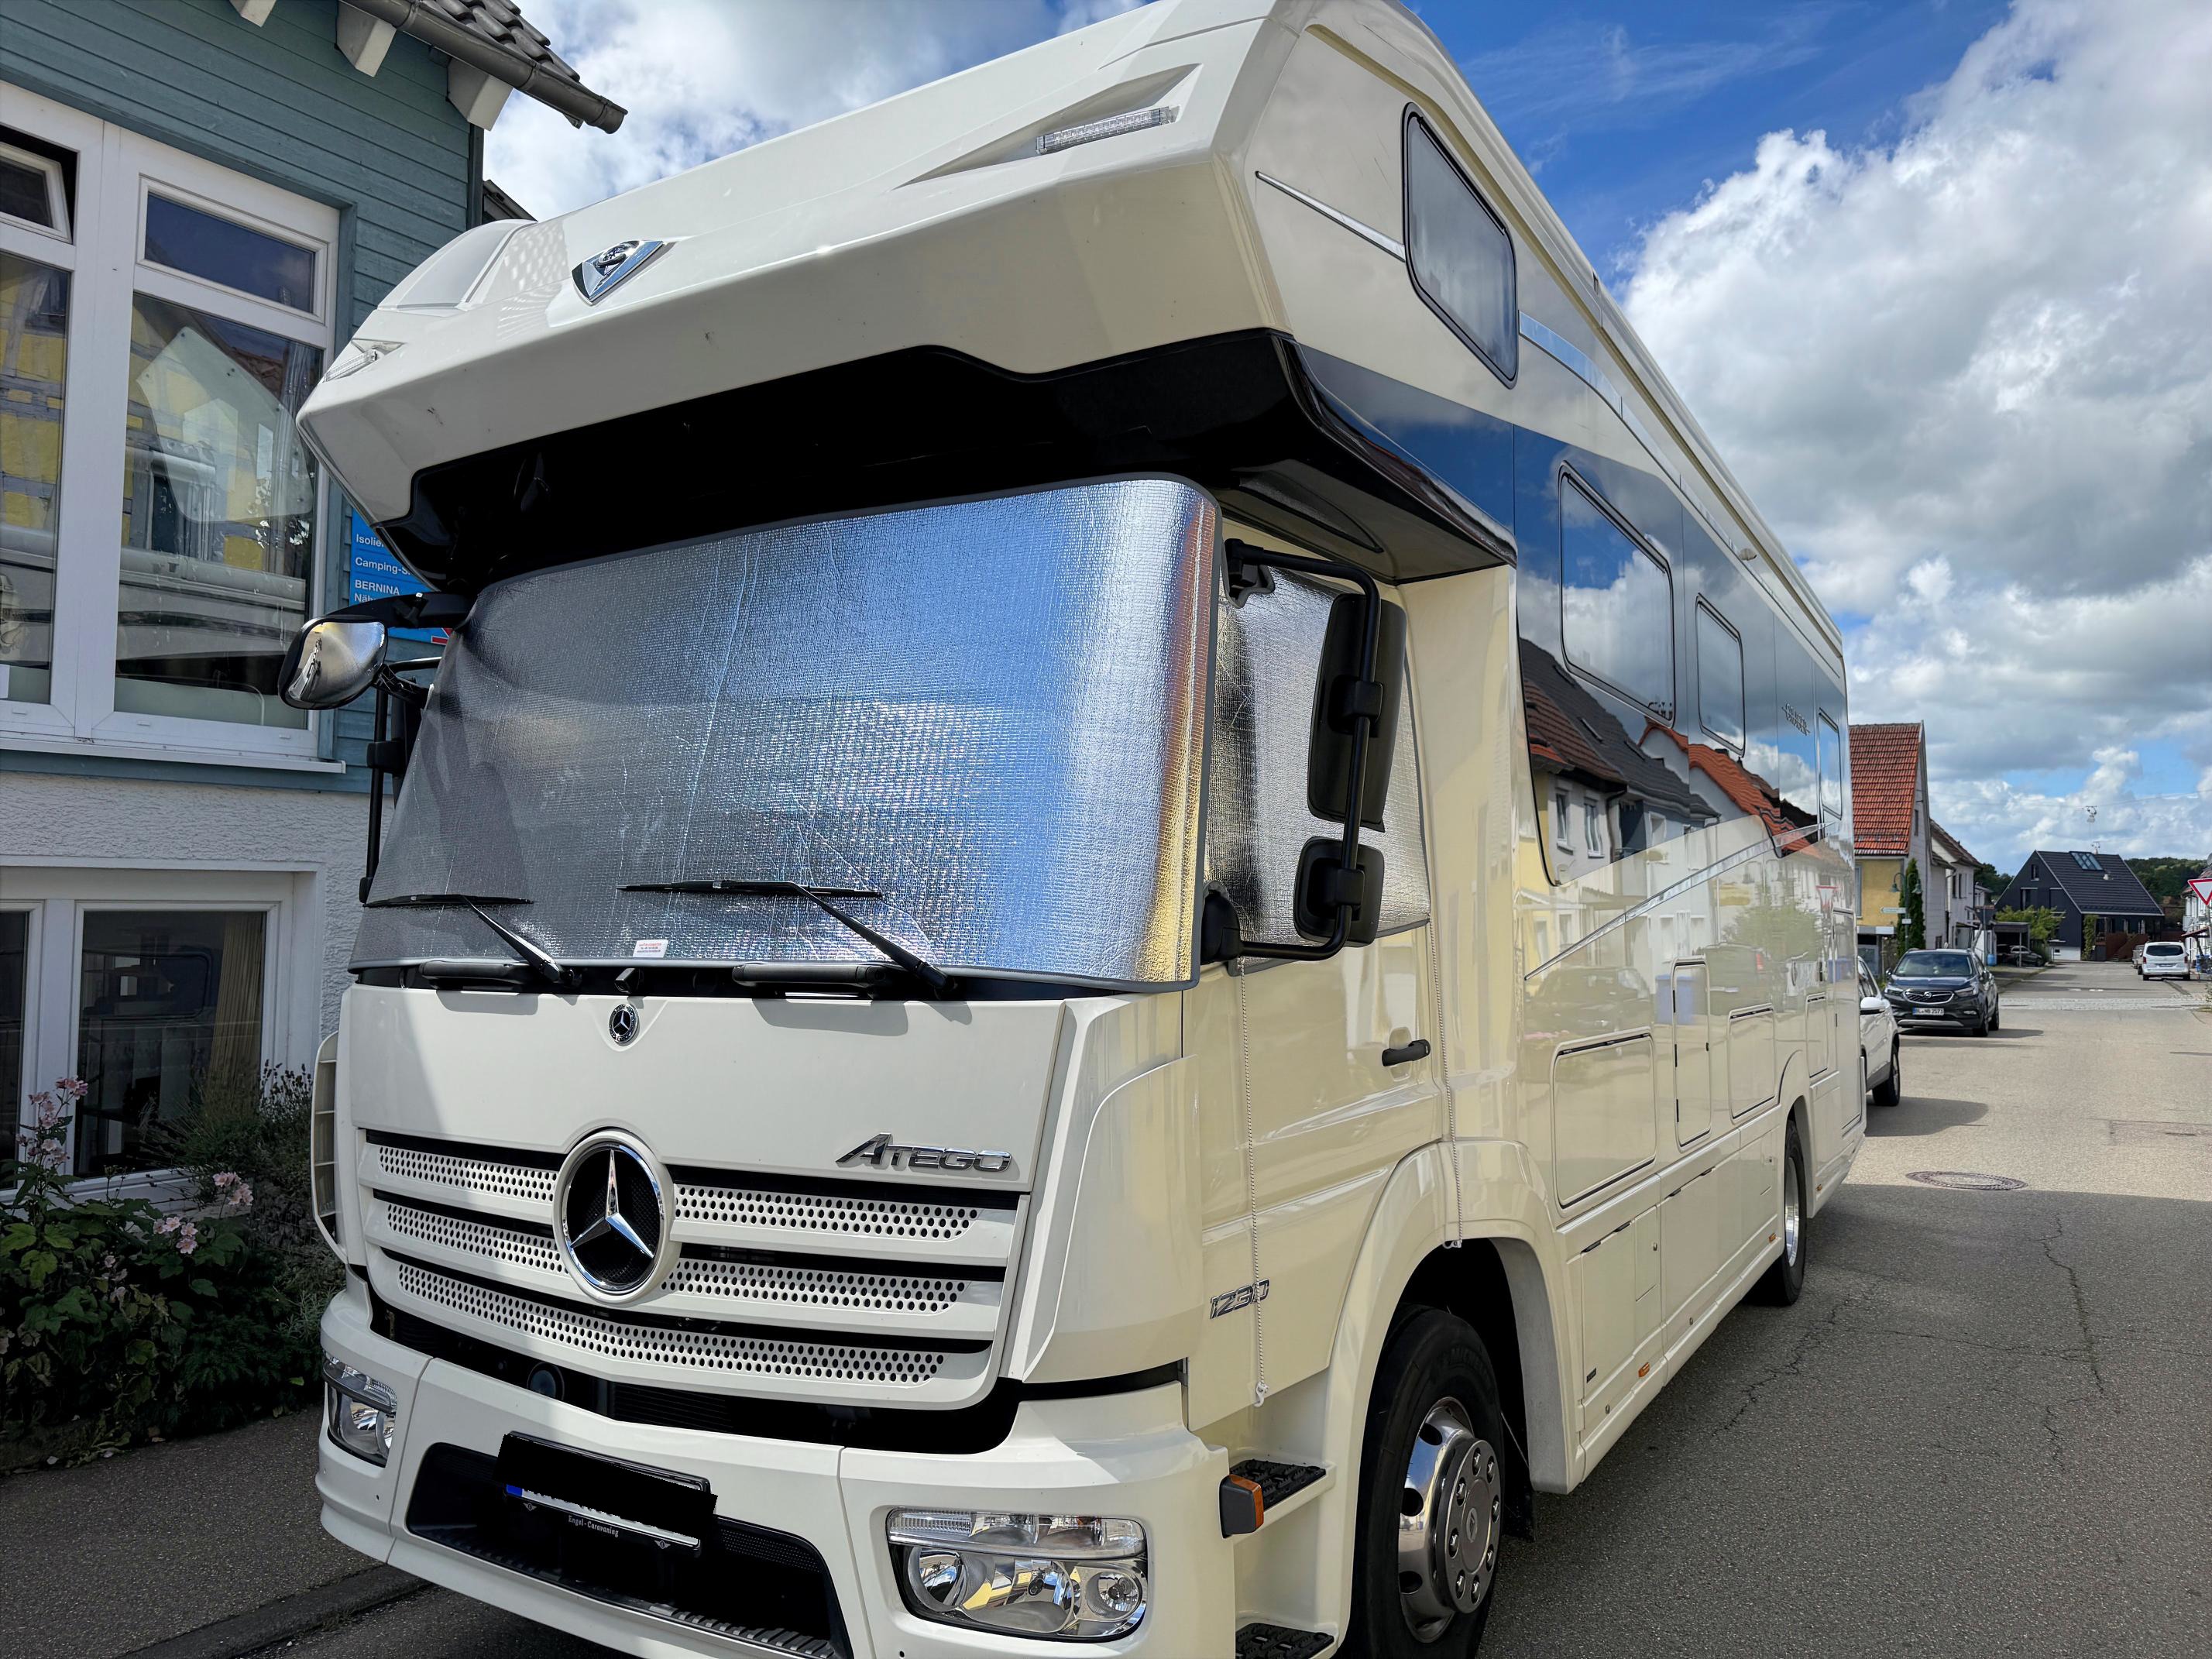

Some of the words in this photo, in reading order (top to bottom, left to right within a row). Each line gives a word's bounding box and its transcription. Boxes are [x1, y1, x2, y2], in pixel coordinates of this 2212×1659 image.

[356, 534, 384, 548] Isolie
[356, 557, 410, 575] Camping-S
[355, 579, 400, 595] BERNINA
[355, 593, 376, 603] Näh
[836, 1132, 1012, 1173] ATEGO
[1210, 1278, 1269, 1319] 1230
